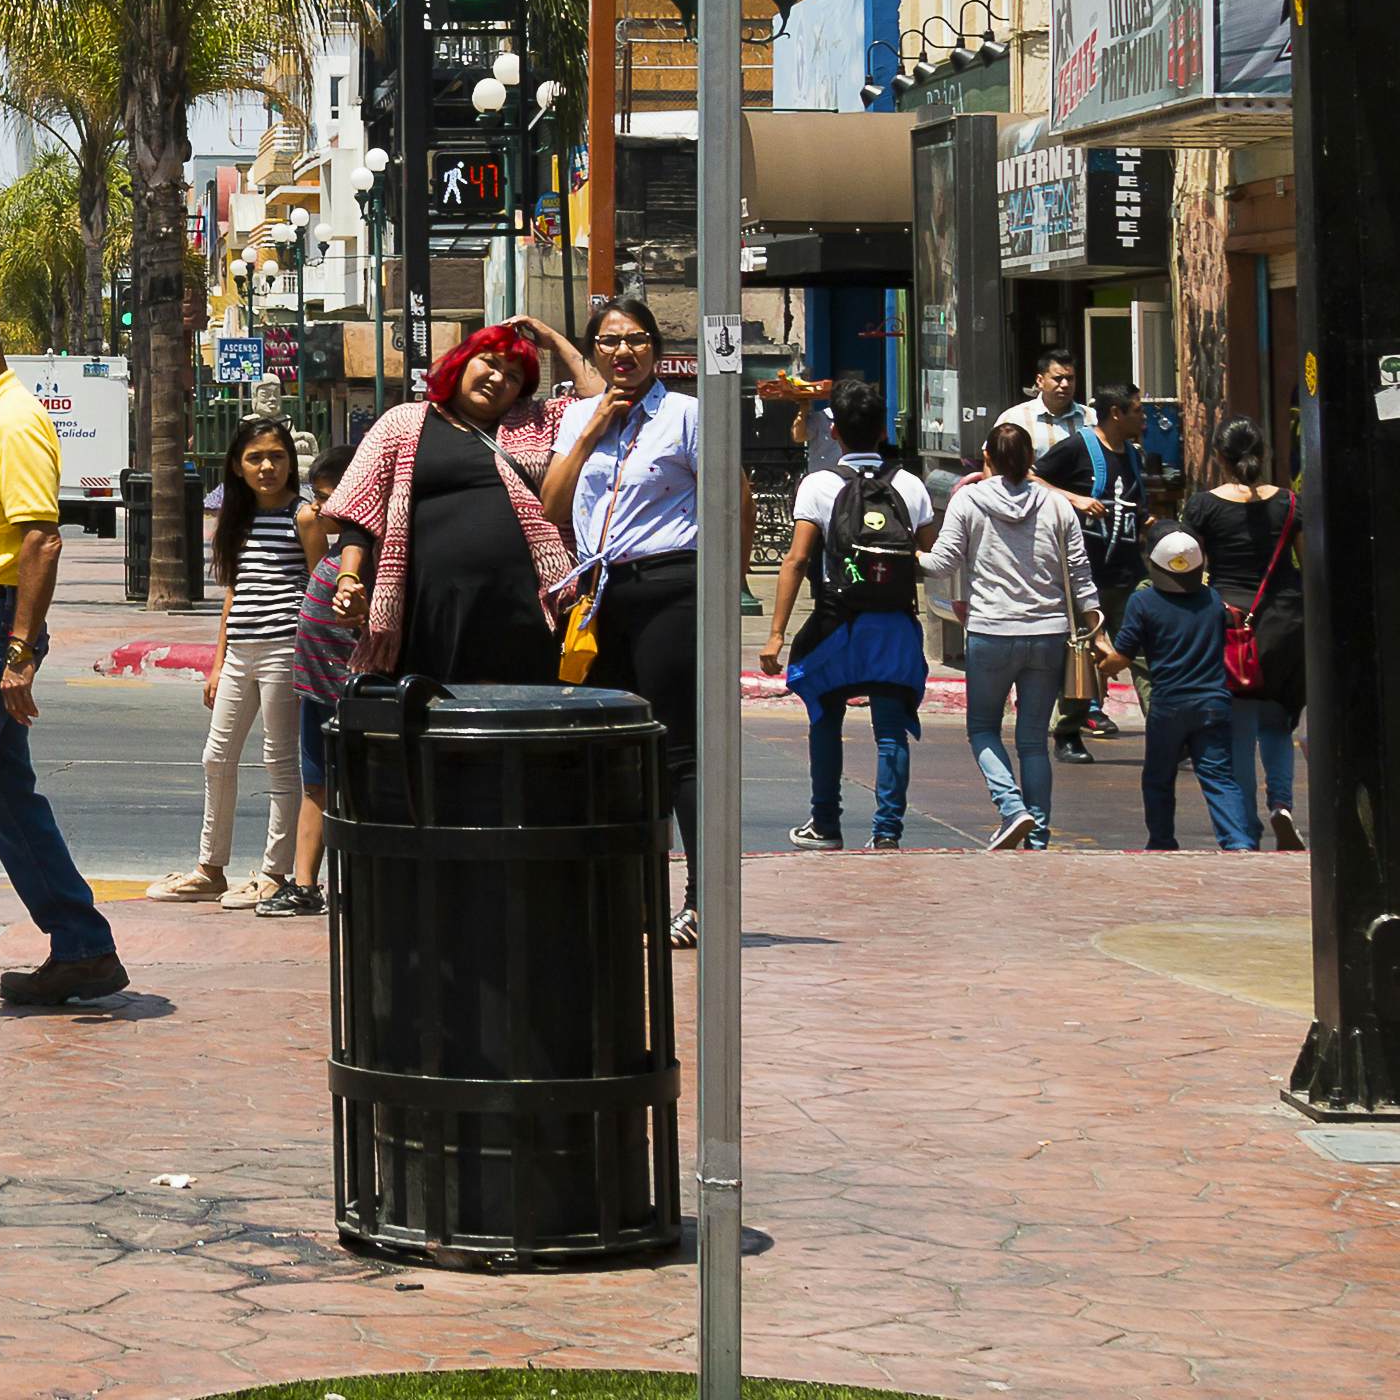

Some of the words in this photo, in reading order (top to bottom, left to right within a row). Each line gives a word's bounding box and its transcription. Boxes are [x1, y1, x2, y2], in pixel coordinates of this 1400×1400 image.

[1056, 26, 1098, 125] TECATE
[1100, 28, 1164, 105] PREMIUM
[469, 163, 499, 199] 47
[996, 144, 1083, 194] INTERNET
[1115, 147, 1141, 248] NTERNET
[223, 343, 259, 353] ASCENSO
[653, 359, 698, 376] TELNO
[39, 398, 72, 410] MBO
[52, 420, 78, 428] mos
